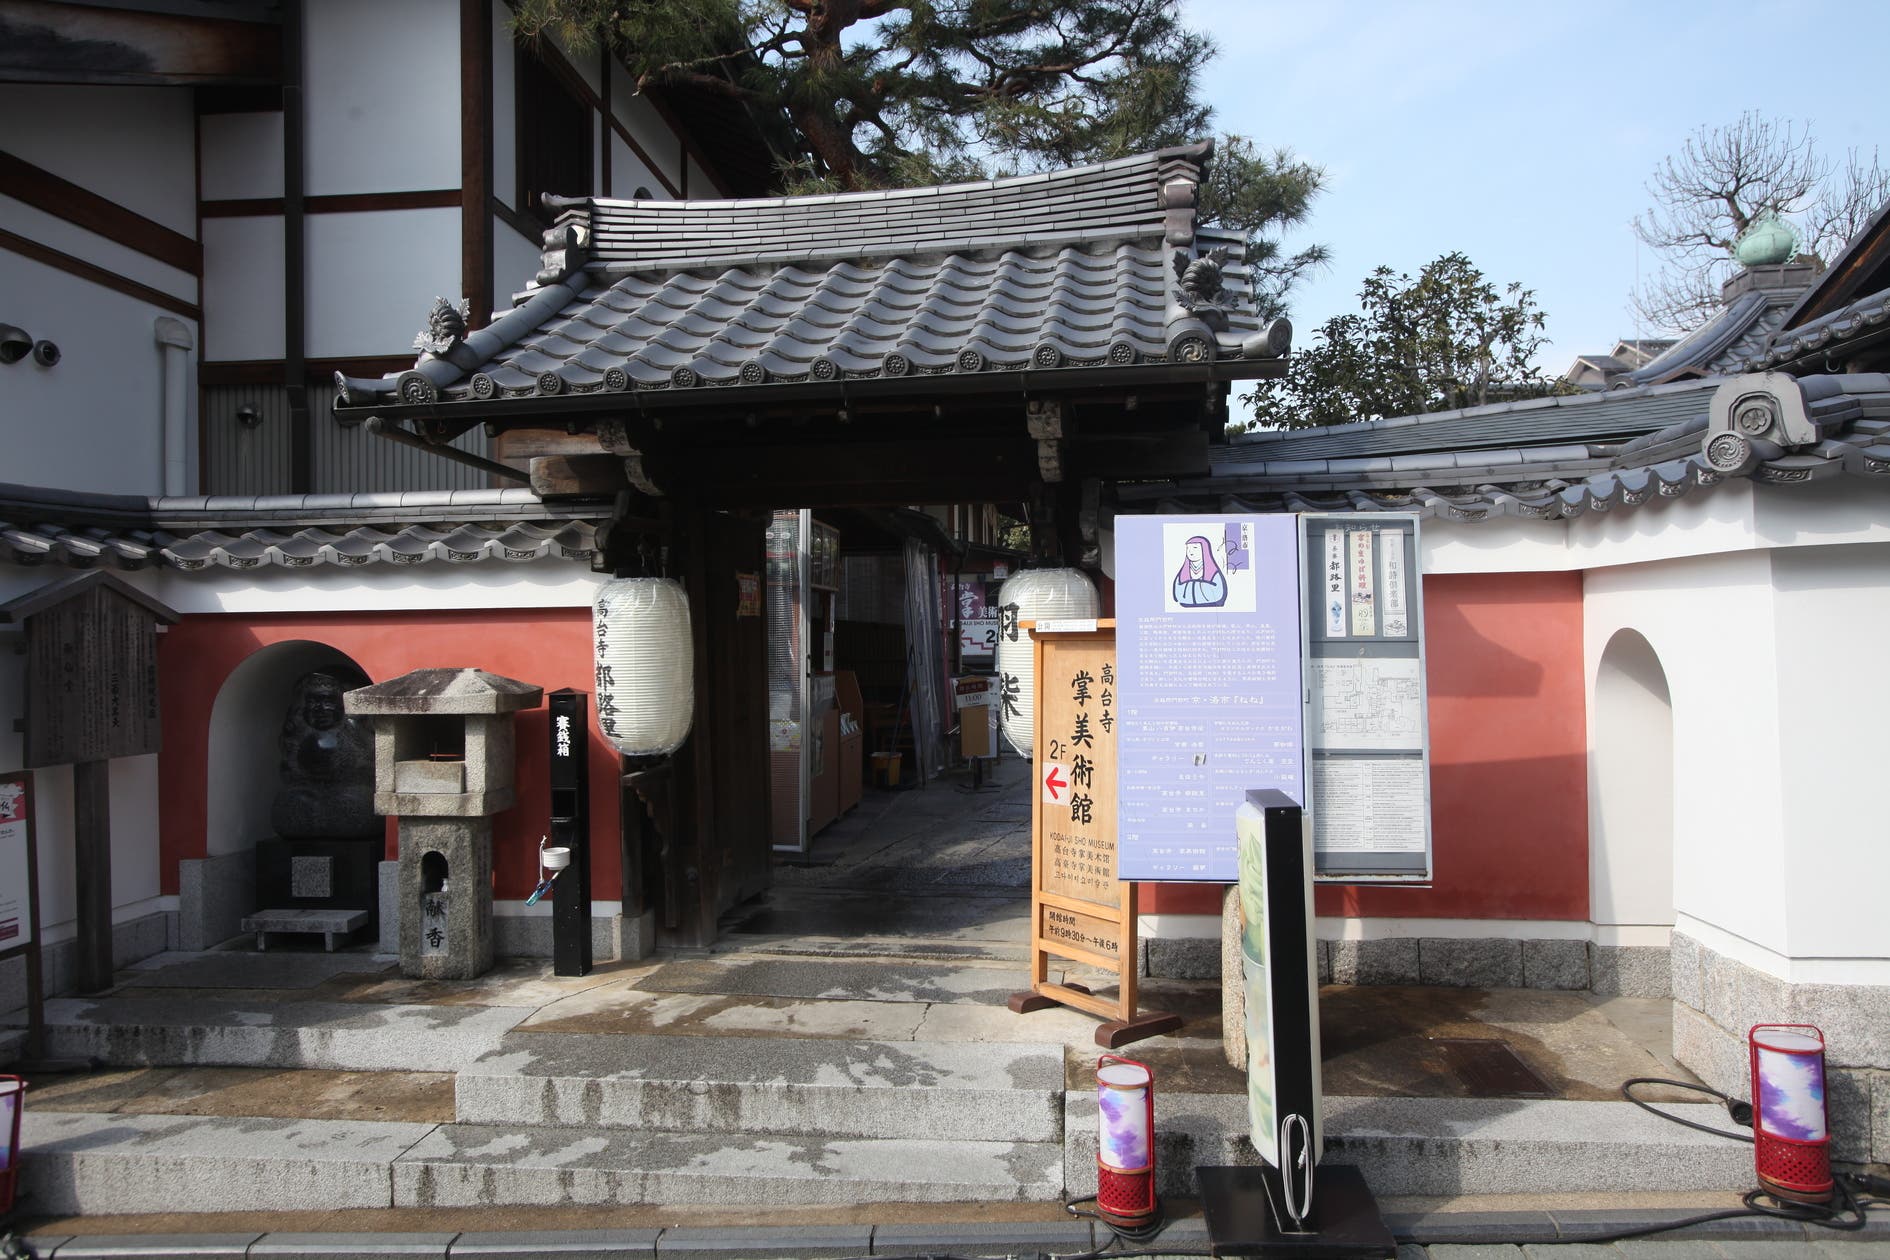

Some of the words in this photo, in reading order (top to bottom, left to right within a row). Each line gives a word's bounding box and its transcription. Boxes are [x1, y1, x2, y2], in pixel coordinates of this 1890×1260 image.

[1099, 662, 1115, 734] 高台寺
[1049, 739, 1067, 760] 2F
[1070, 670, 1095, 826] 掌美術館
[1074, 836, 1087, 846] SHO
[1088, 838, 1115, 852] MUSEUM
[424, 899, 446, 949] 献香
[1048, 911, 1076, 927] 開館時間
